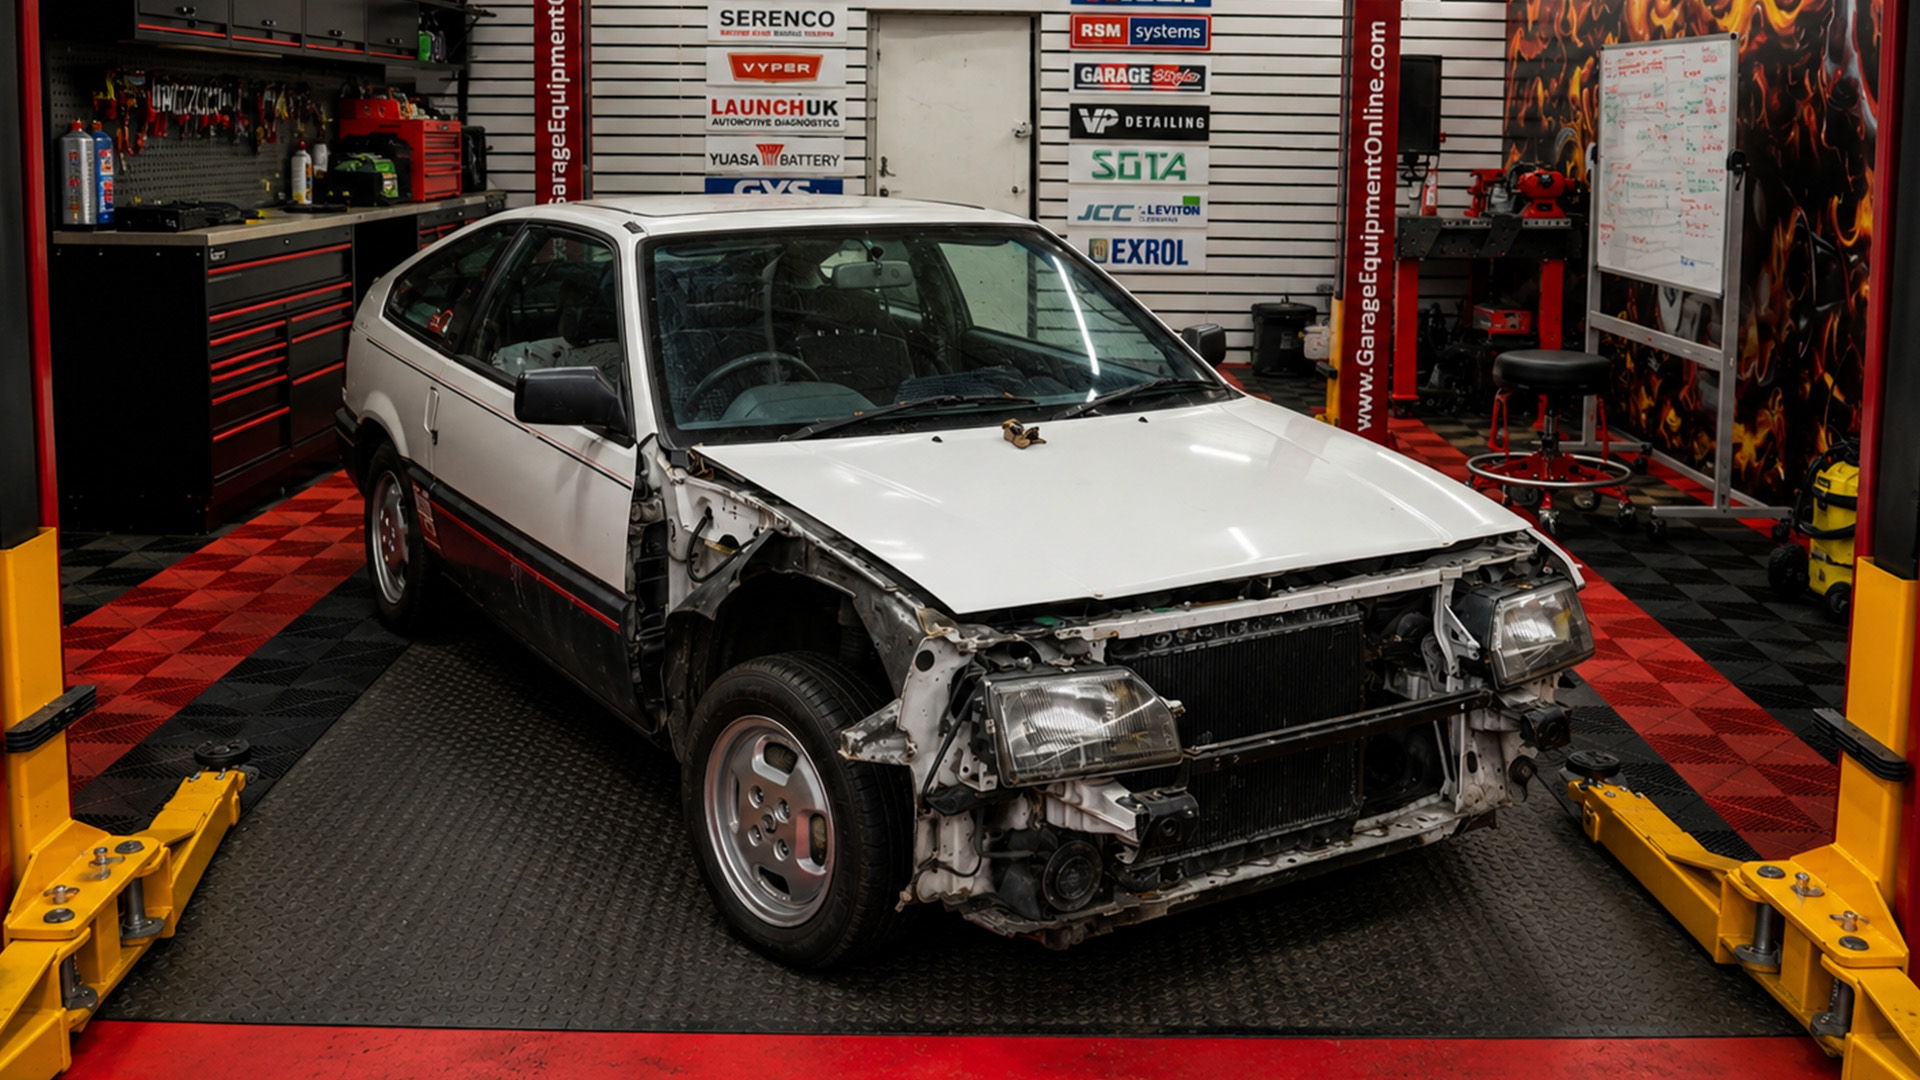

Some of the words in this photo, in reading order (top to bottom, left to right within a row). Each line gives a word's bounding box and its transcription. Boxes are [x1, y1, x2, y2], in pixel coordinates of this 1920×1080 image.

[720, 10, 835, 27] SERENCO
[1081, 23, 1120, 37] RSM
[1135, 24, 1201, 41] systems
[743, 63, 810, 73] VYPER
[1080, 66, 1151, 83] GARAGE
[547, 0, 571, 205] arageEquipment
[711, 98, 838, 116] LAUNCHUK
[1078, 108, 1119, 134] VP
[1125, 116, 1205, 128] DETAILING
[710, 153, 759, 166] YUASA
[780, 154, 840, 167] BATTERY
[1077, 204, 1135, 221] JCC
[1147, 205, 1201, 215] LEVITON
[1357, 20, 1386, 431] www.GarageEquipmentOnline.com
[1111, 238, 1189, 266] EXROL
